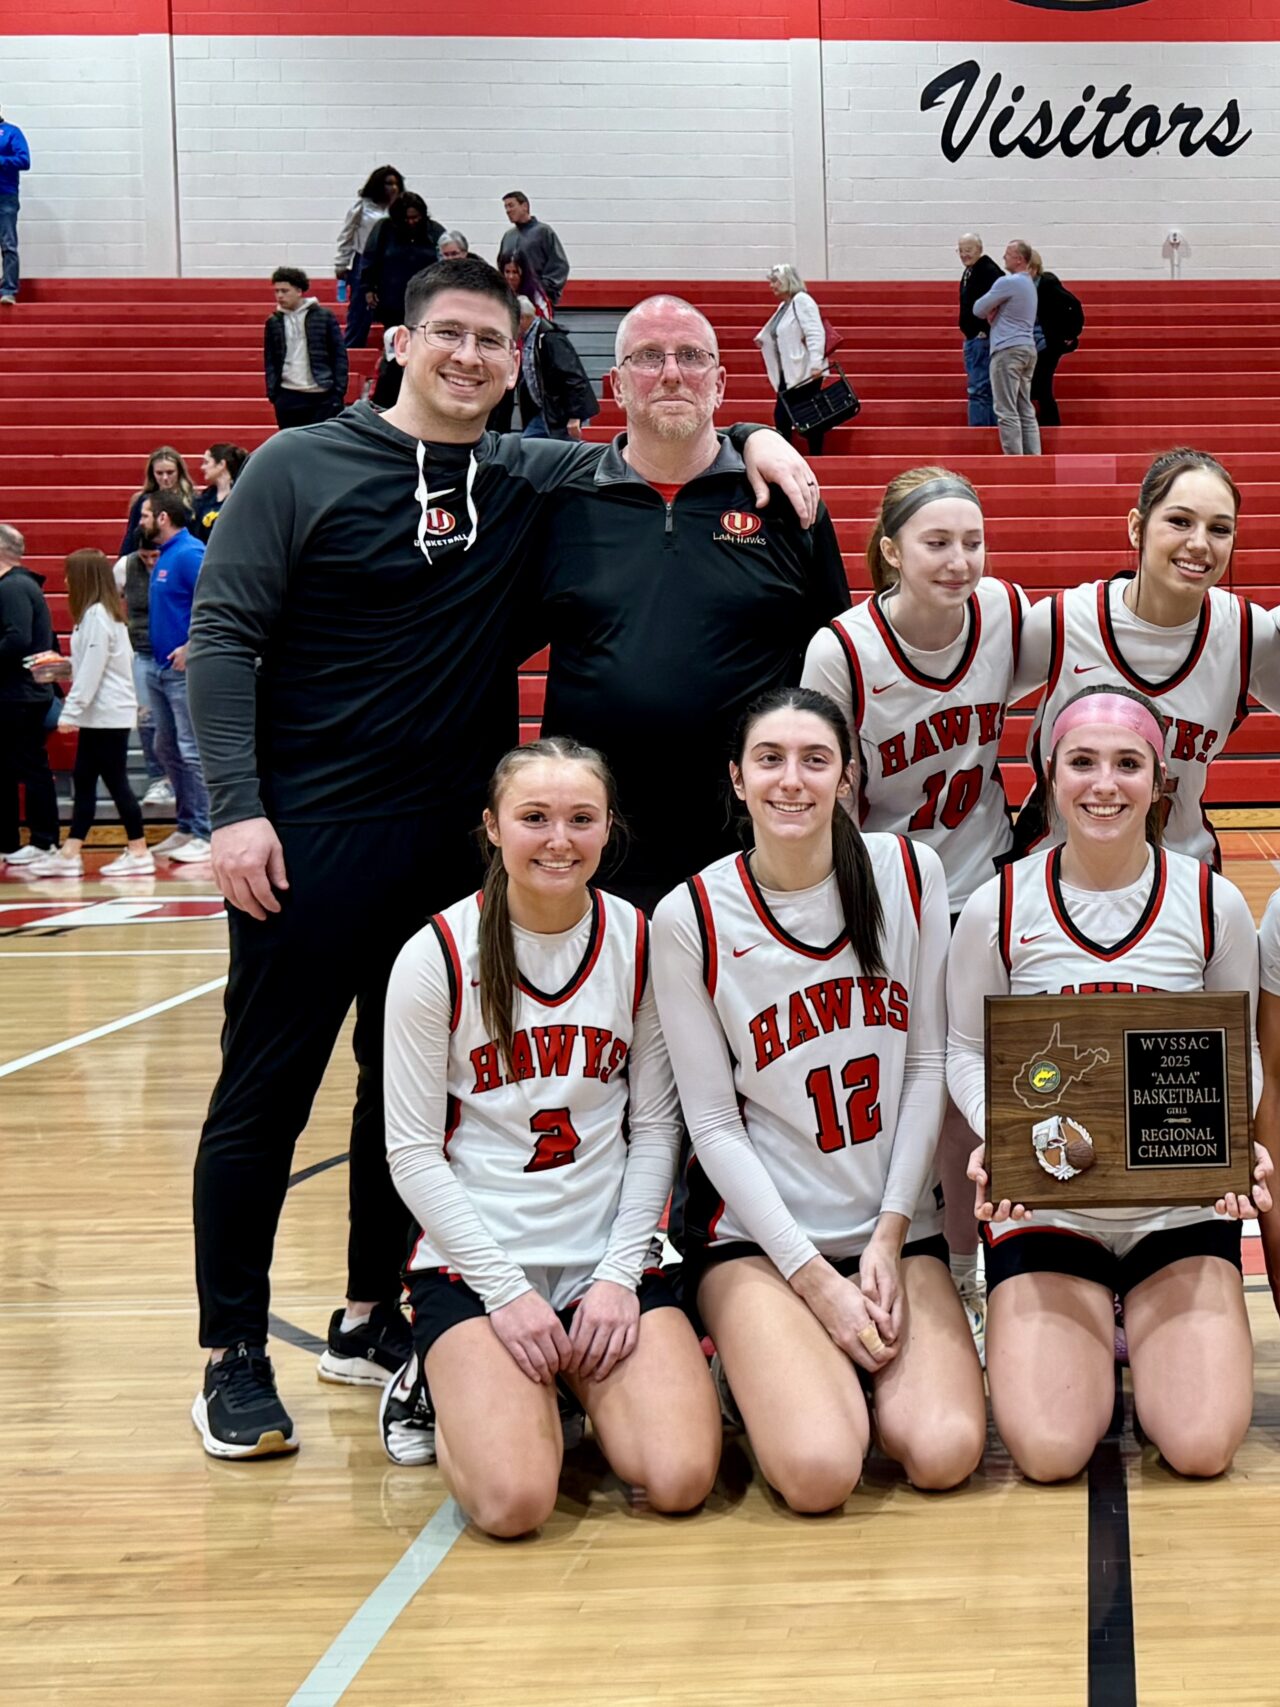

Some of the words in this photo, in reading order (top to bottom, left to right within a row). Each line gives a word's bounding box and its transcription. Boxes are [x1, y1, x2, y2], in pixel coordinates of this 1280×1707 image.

[920, 60, 1252, 163] Visitors
[414, 533, 469, 547] BSKETBALL
[908, 764, 984, 832] 10
[749, 976, 909, 1072] HAWKS
[1140, 1036, 1210, 1051] WVSSAC
[470, 1024, 628, 1094] HAWKS
[1160, 1055, 1191, 1068] 2025
[805, 1053, 882, 1154] 12
[1133, 1087, 1221, 1105] BASKETBALL
[523, 1107, 581, 1173] 2
[1138, 1143, 1218, 1158] CHAMPION
[1141, 1127, 1215, 1142] REGIONAL
